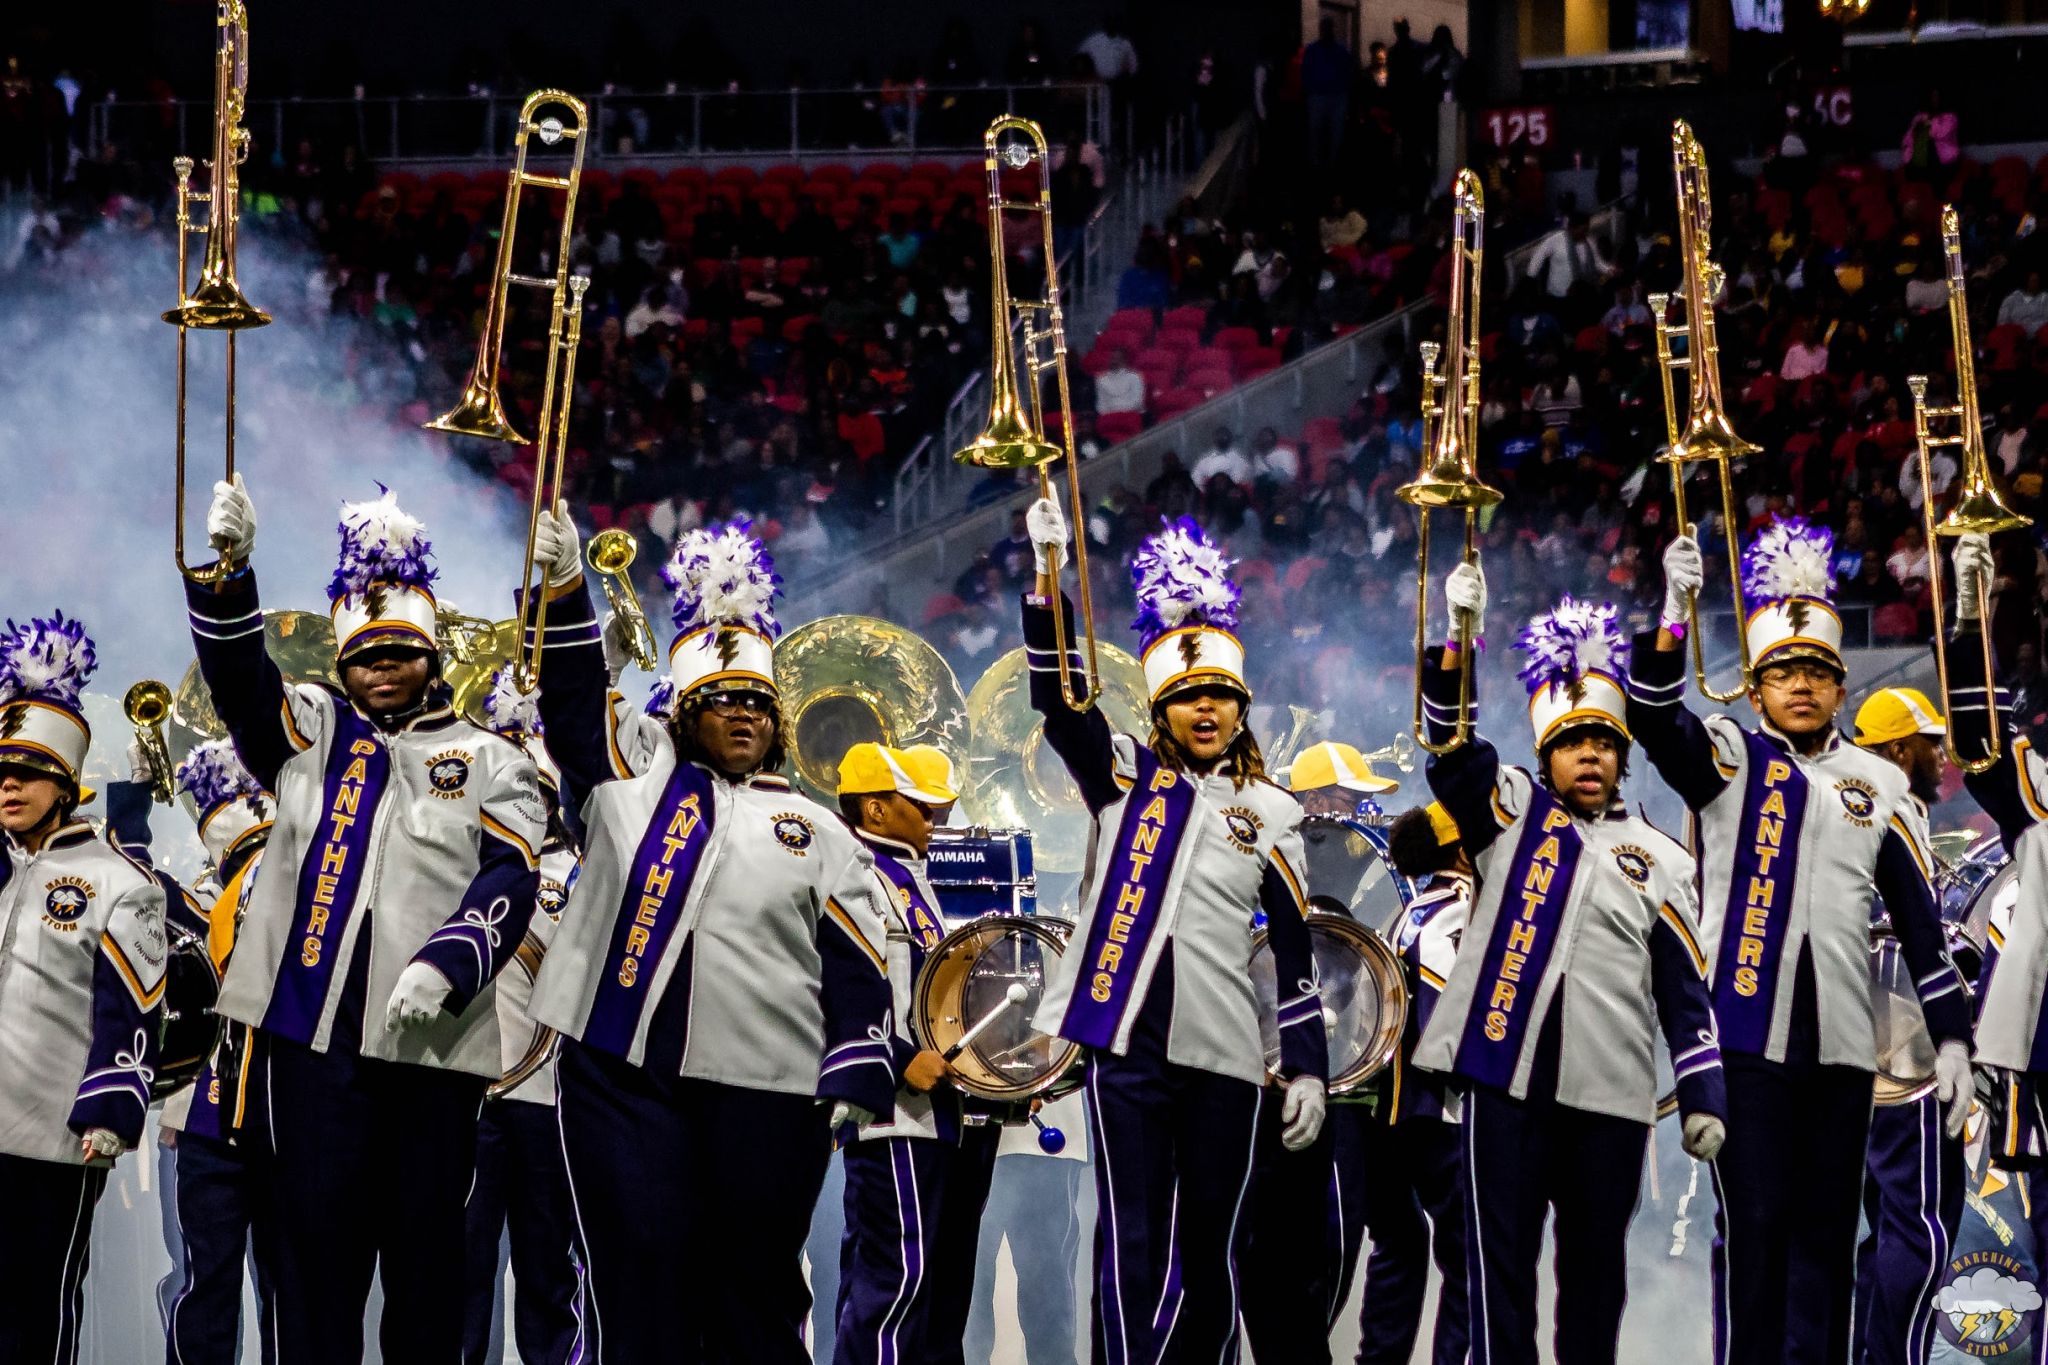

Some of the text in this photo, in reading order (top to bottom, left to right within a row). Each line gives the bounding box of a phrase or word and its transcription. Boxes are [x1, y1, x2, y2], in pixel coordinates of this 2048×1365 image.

[1488, 109, 1548, 148] 125
[424, 748, 475, 768] MARCHING
[428, 787, 466, 801] STORM
[301, 740, 377, 967] PANTHERS
[927, 851, 986, 863] YAMAHA
[45, 876, 97, 900] MARCHING
[1091, 769, 1178, 1003] PANTHERS
[1733, 760, 1792, 998] PANTHERS
[41, 914, 78, 932] STORM
[1484, 808, 1571, 1041] PANTHERS
